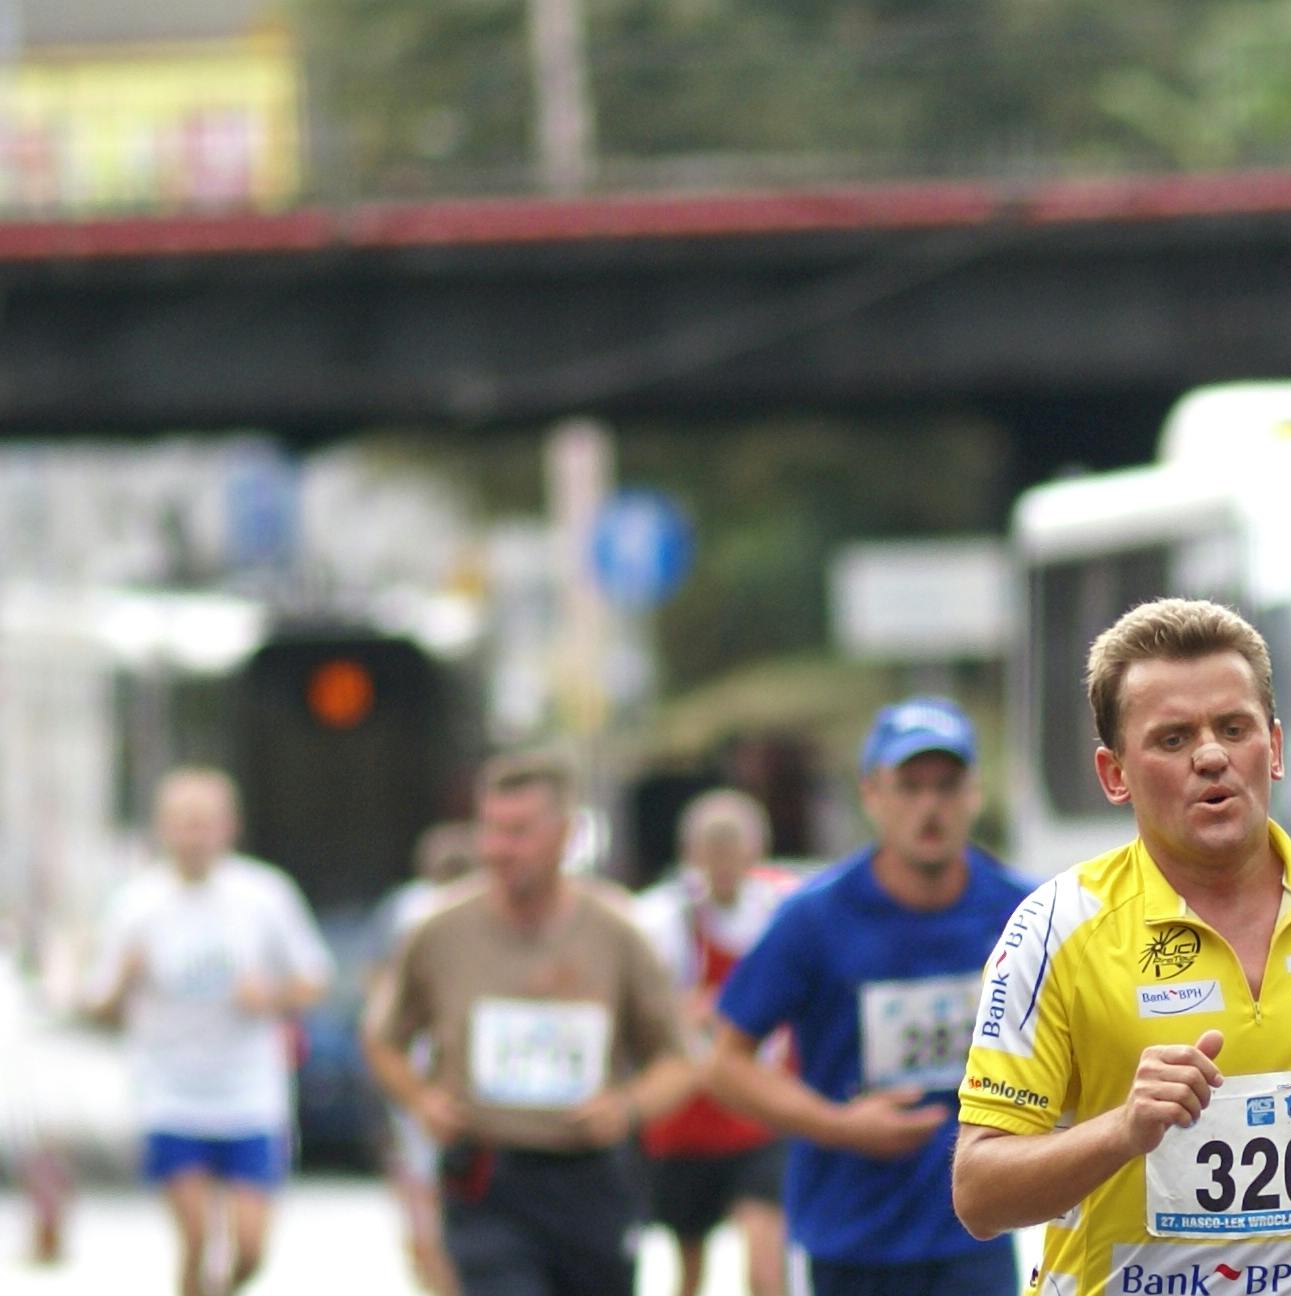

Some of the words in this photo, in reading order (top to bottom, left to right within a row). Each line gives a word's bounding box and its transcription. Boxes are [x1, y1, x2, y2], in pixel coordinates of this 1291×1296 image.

[982, 972, 1010, 1038] Bank
[1142, 990, 1170, 1003] Bank
[1179, 988, 1202, 1000] BPH
[1160, 1216, 1179, 1228] 27.
[1181, 1215, 1246, 1229] HASCO-LEK
[1121, 1264, 1210, 1296] Bank
